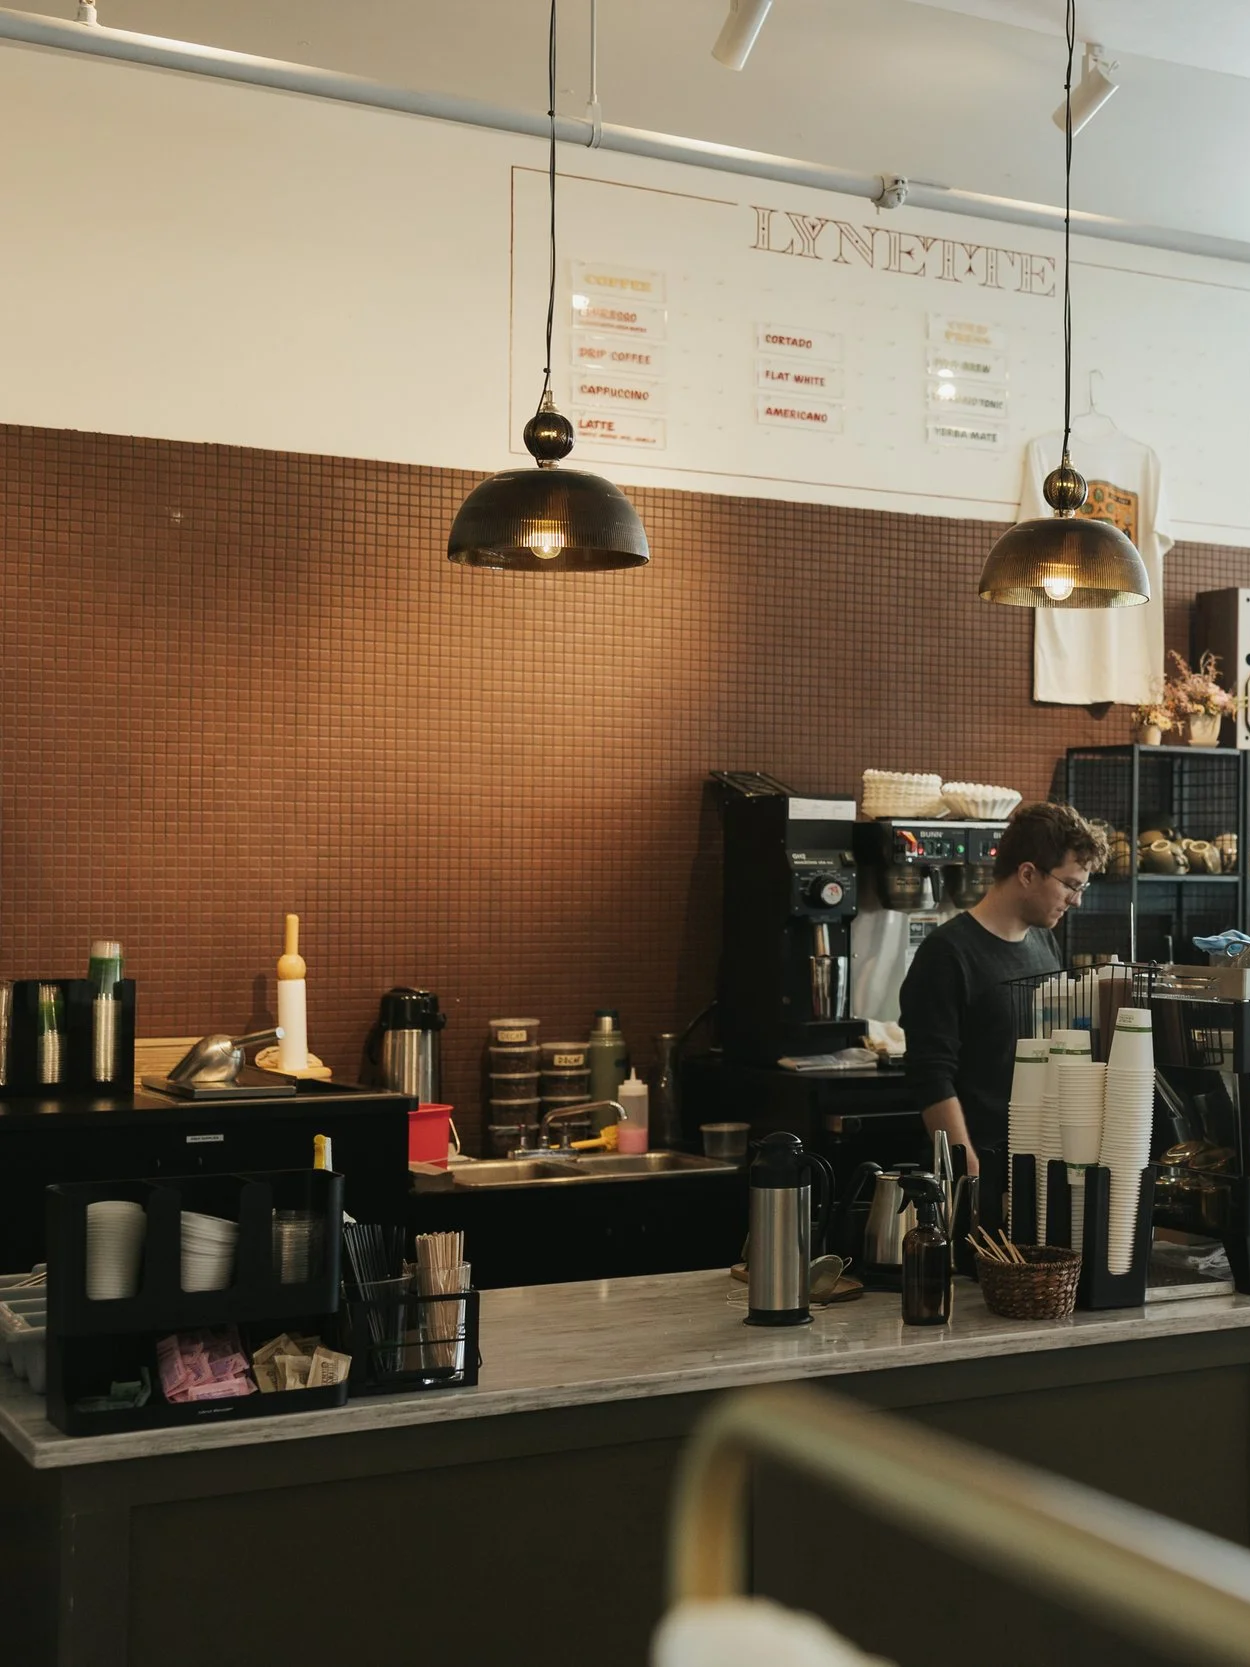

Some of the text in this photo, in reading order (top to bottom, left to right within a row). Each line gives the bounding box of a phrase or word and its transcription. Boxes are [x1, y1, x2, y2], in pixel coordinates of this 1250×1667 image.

[749, 206, 1056, 297] LYNETTE
[579, 307, 637, 323] SPRESSO
[765, 334, 812, 349] CORTADO
[578, 347, 652, 365] DRIP COFFEE
[765, 369, 827, 387] FLAT WHITE
[580, 384, 649, 400] CAPPUCCINO
[765, 407, 829, 423] AMERICANO
[578, 419, 615, 431] LATTE
[970, 431, 998, 442] MATE
